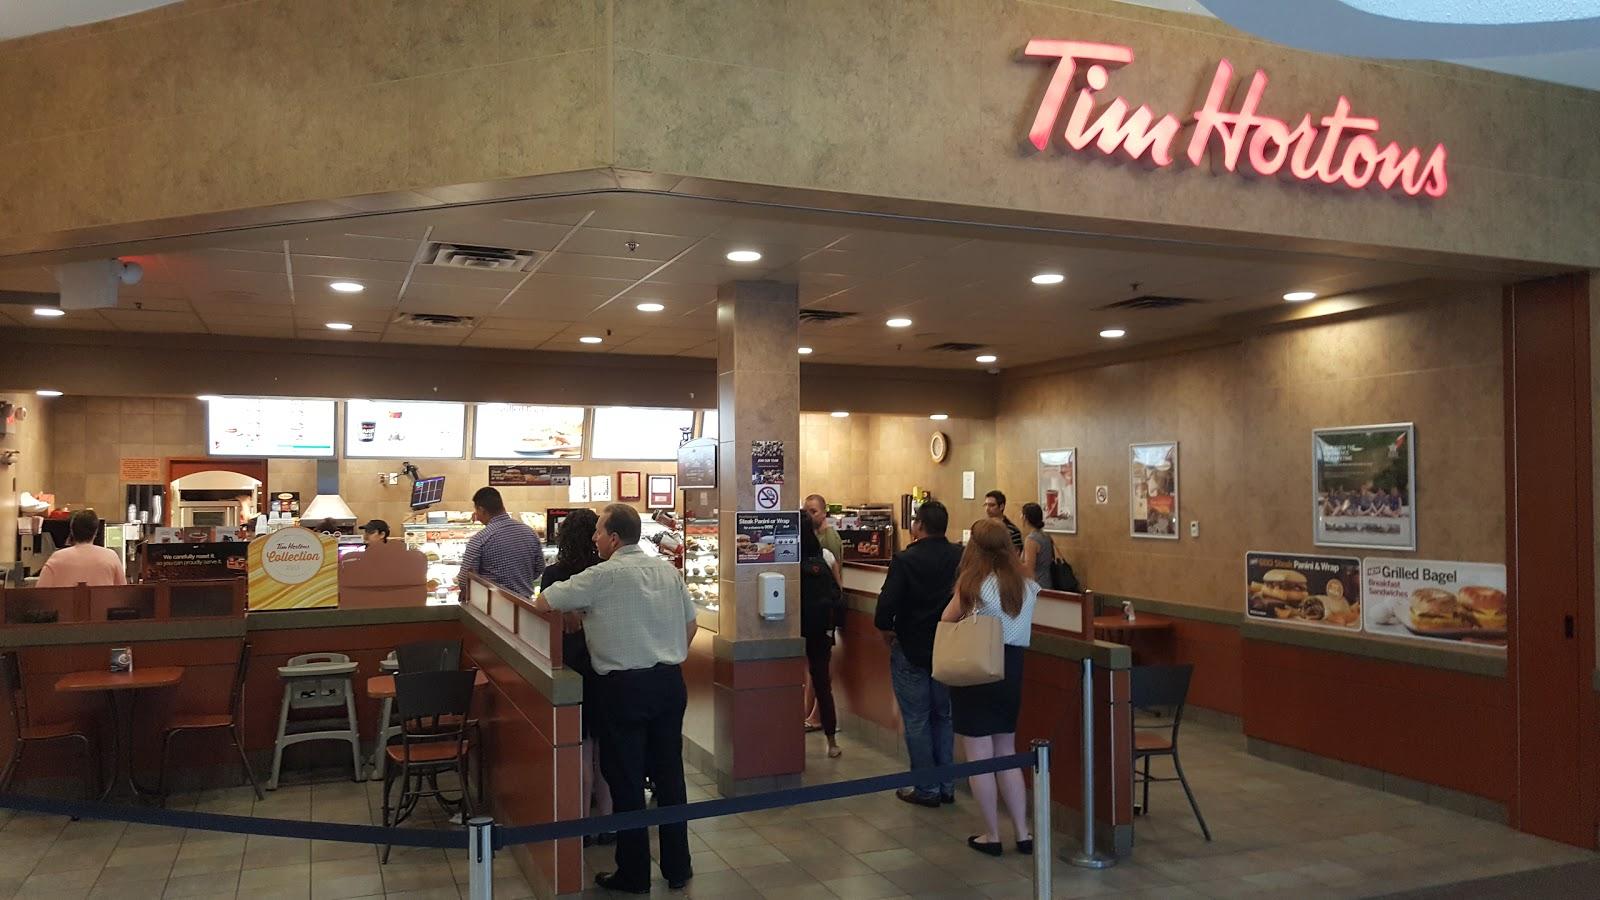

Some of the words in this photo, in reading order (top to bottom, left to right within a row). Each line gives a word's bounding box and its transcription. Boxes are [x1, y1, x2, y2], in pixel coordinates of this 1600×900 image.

[1024, 39, 1181, 167] Tim
[1187, 57, 1448, 197] Hortons
[173, 553, 195, 561] carefully
[266, 550, 320, 563] Collection
[1293, 559, 1314, 570] Panini
[1314, 562, 1320, 570] &
[1320, 562, 1340, 573] Wrap
[1382, 566, 1419, 580] Grilled
[1422, 568, 1457, 585] Bagel
[1368, 579, 1400, 588] Breakfast
[1369, 587, 1409, 598] Sandwiches
